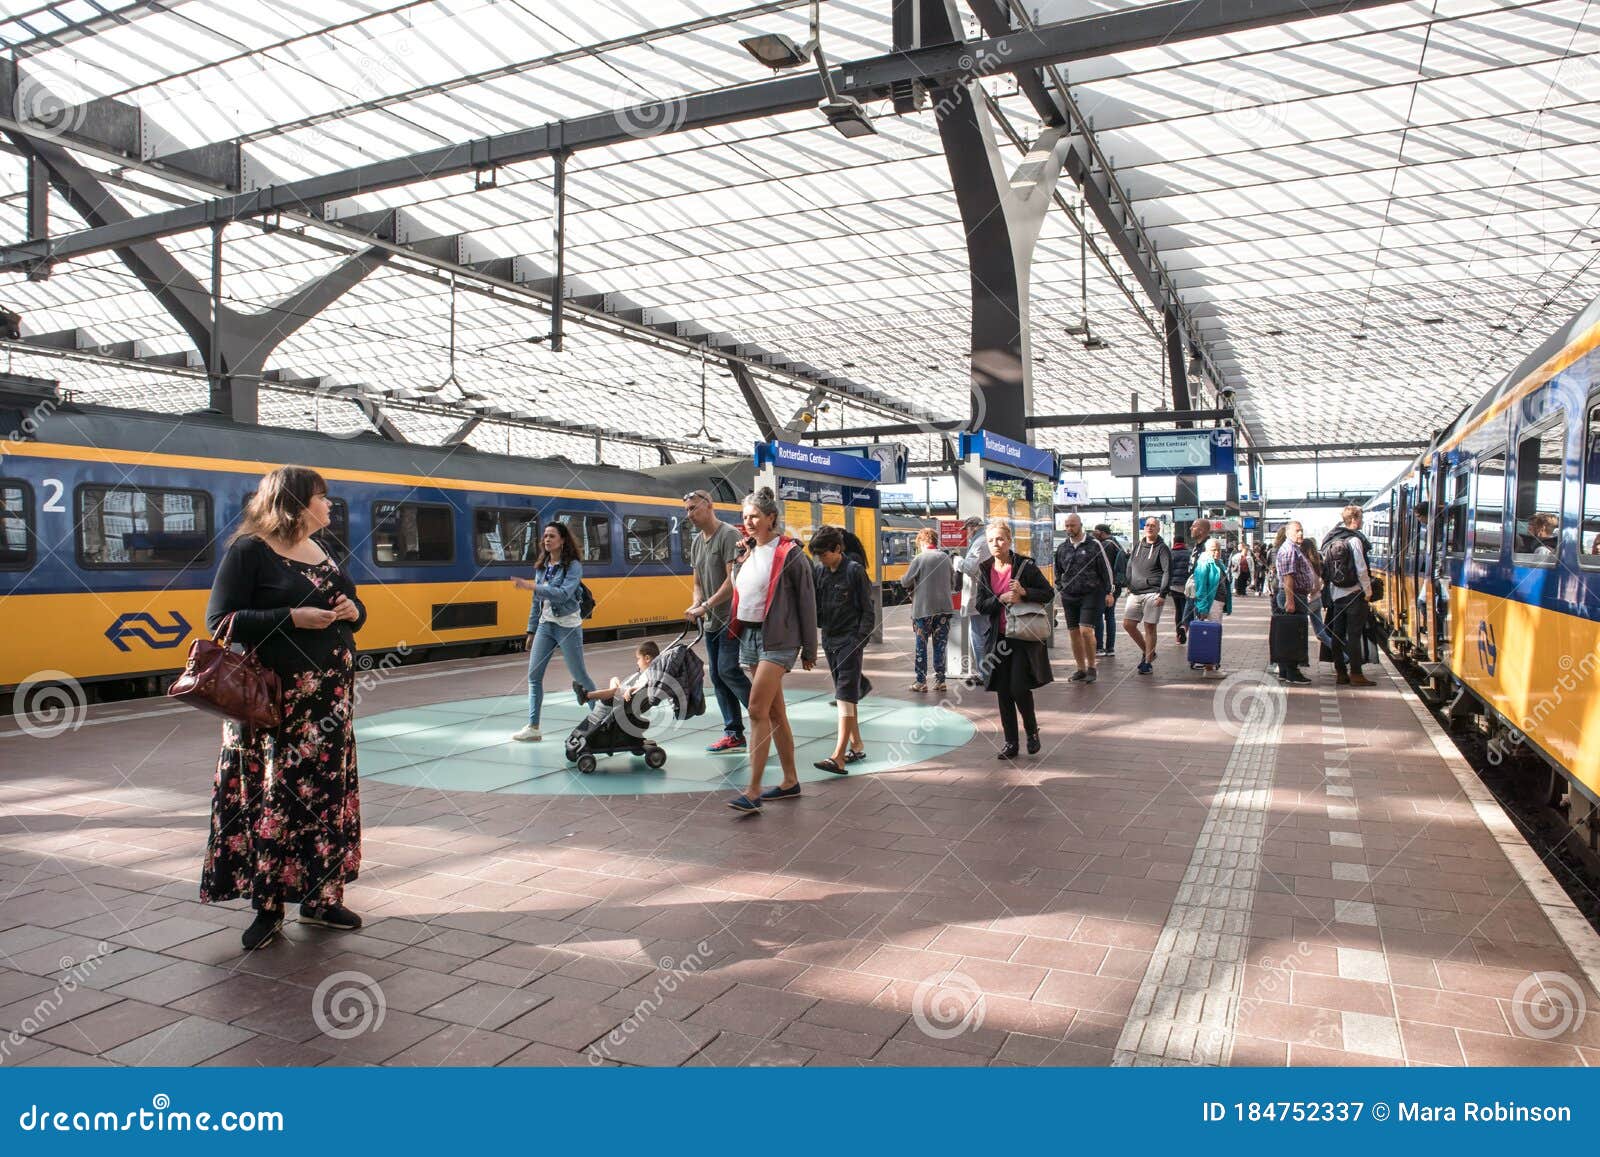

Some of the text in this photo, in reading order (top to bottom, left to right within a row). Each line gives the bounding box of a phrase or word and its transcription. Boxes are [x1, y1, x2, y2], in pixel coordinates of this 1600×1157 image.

[984, 437, 1006, 454] Rotterdam
[778, 446, 831, 466] Rotterdam Centraal
[42, 478, 66, 513] 2
[671, 516, 679, 534] 2
